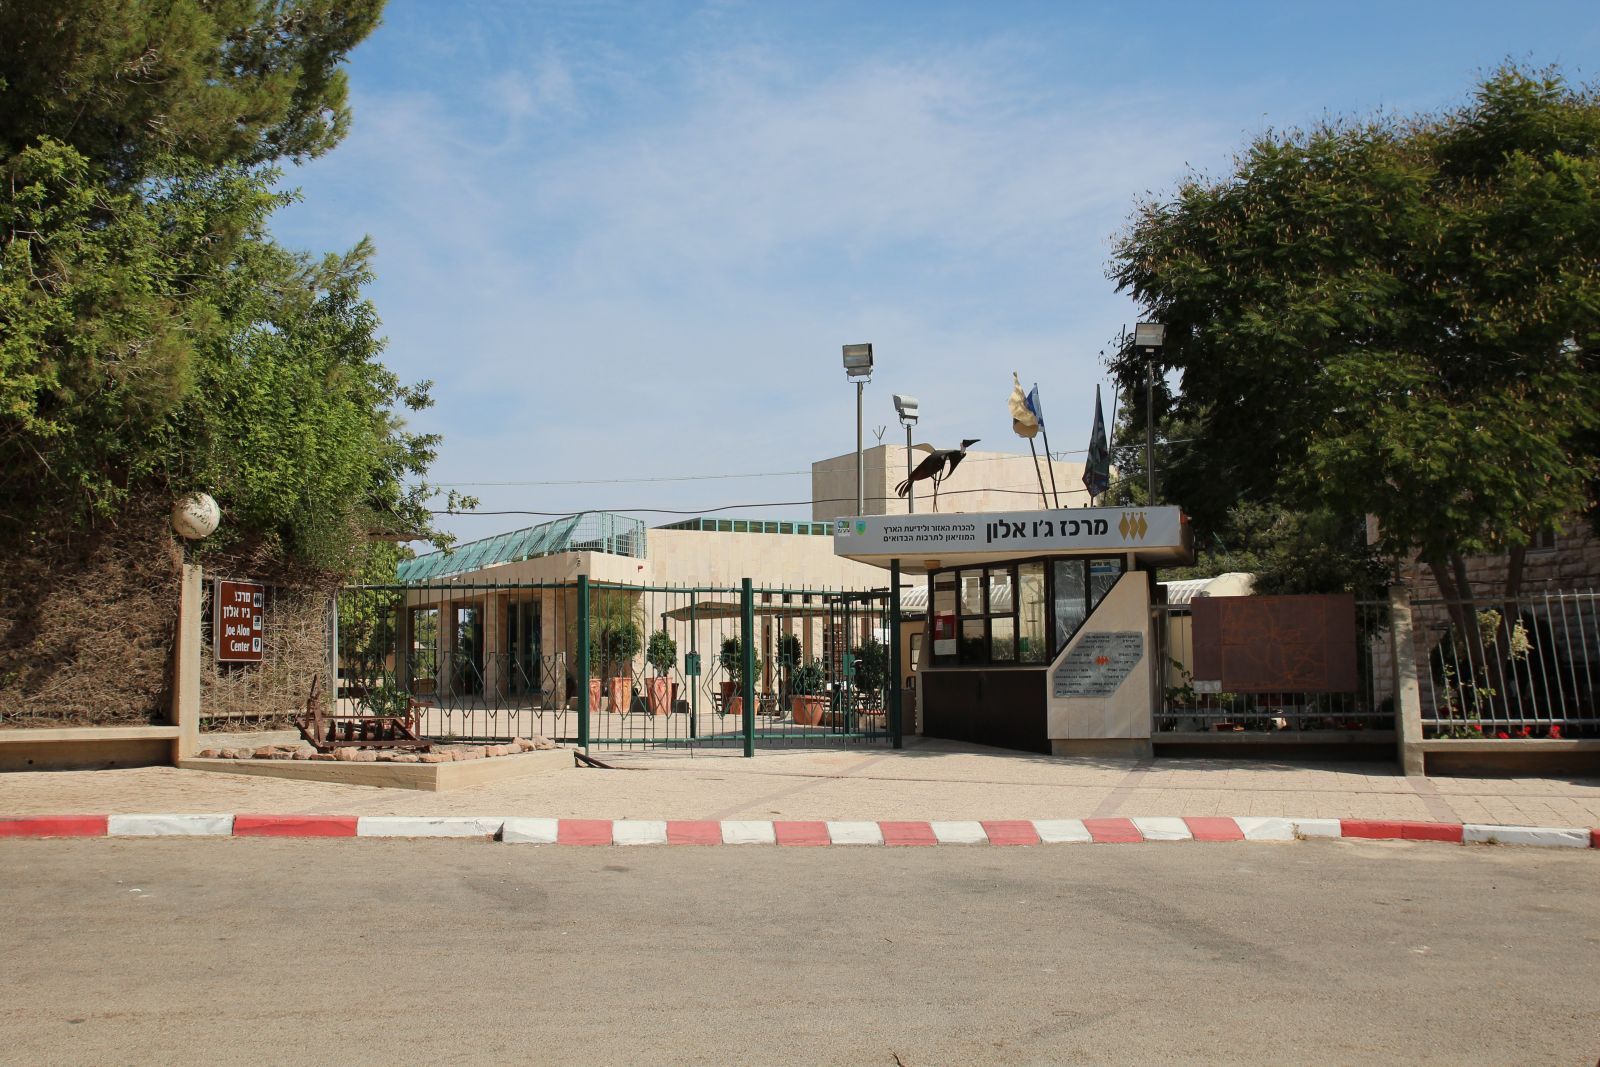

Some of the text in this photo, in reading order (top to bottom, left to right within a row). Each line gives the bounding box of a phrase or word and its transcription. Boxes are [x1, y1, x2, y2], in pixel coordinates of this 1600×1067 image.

[904, 525, 929, 533] ולידיעת
[952, 524, 974, 532] להכרת
[986, 519, 1026, 543] אלון
[1060, 519, 1108, 536] מרכז
[945, 534, 974, 542] המוזיאון
[235, 592, 250, 602] מרכז
[223, 605, 239, 619] אלון
[225, 624, 250, 637] Joe Alon
[230, 640, 250, 652] Center
